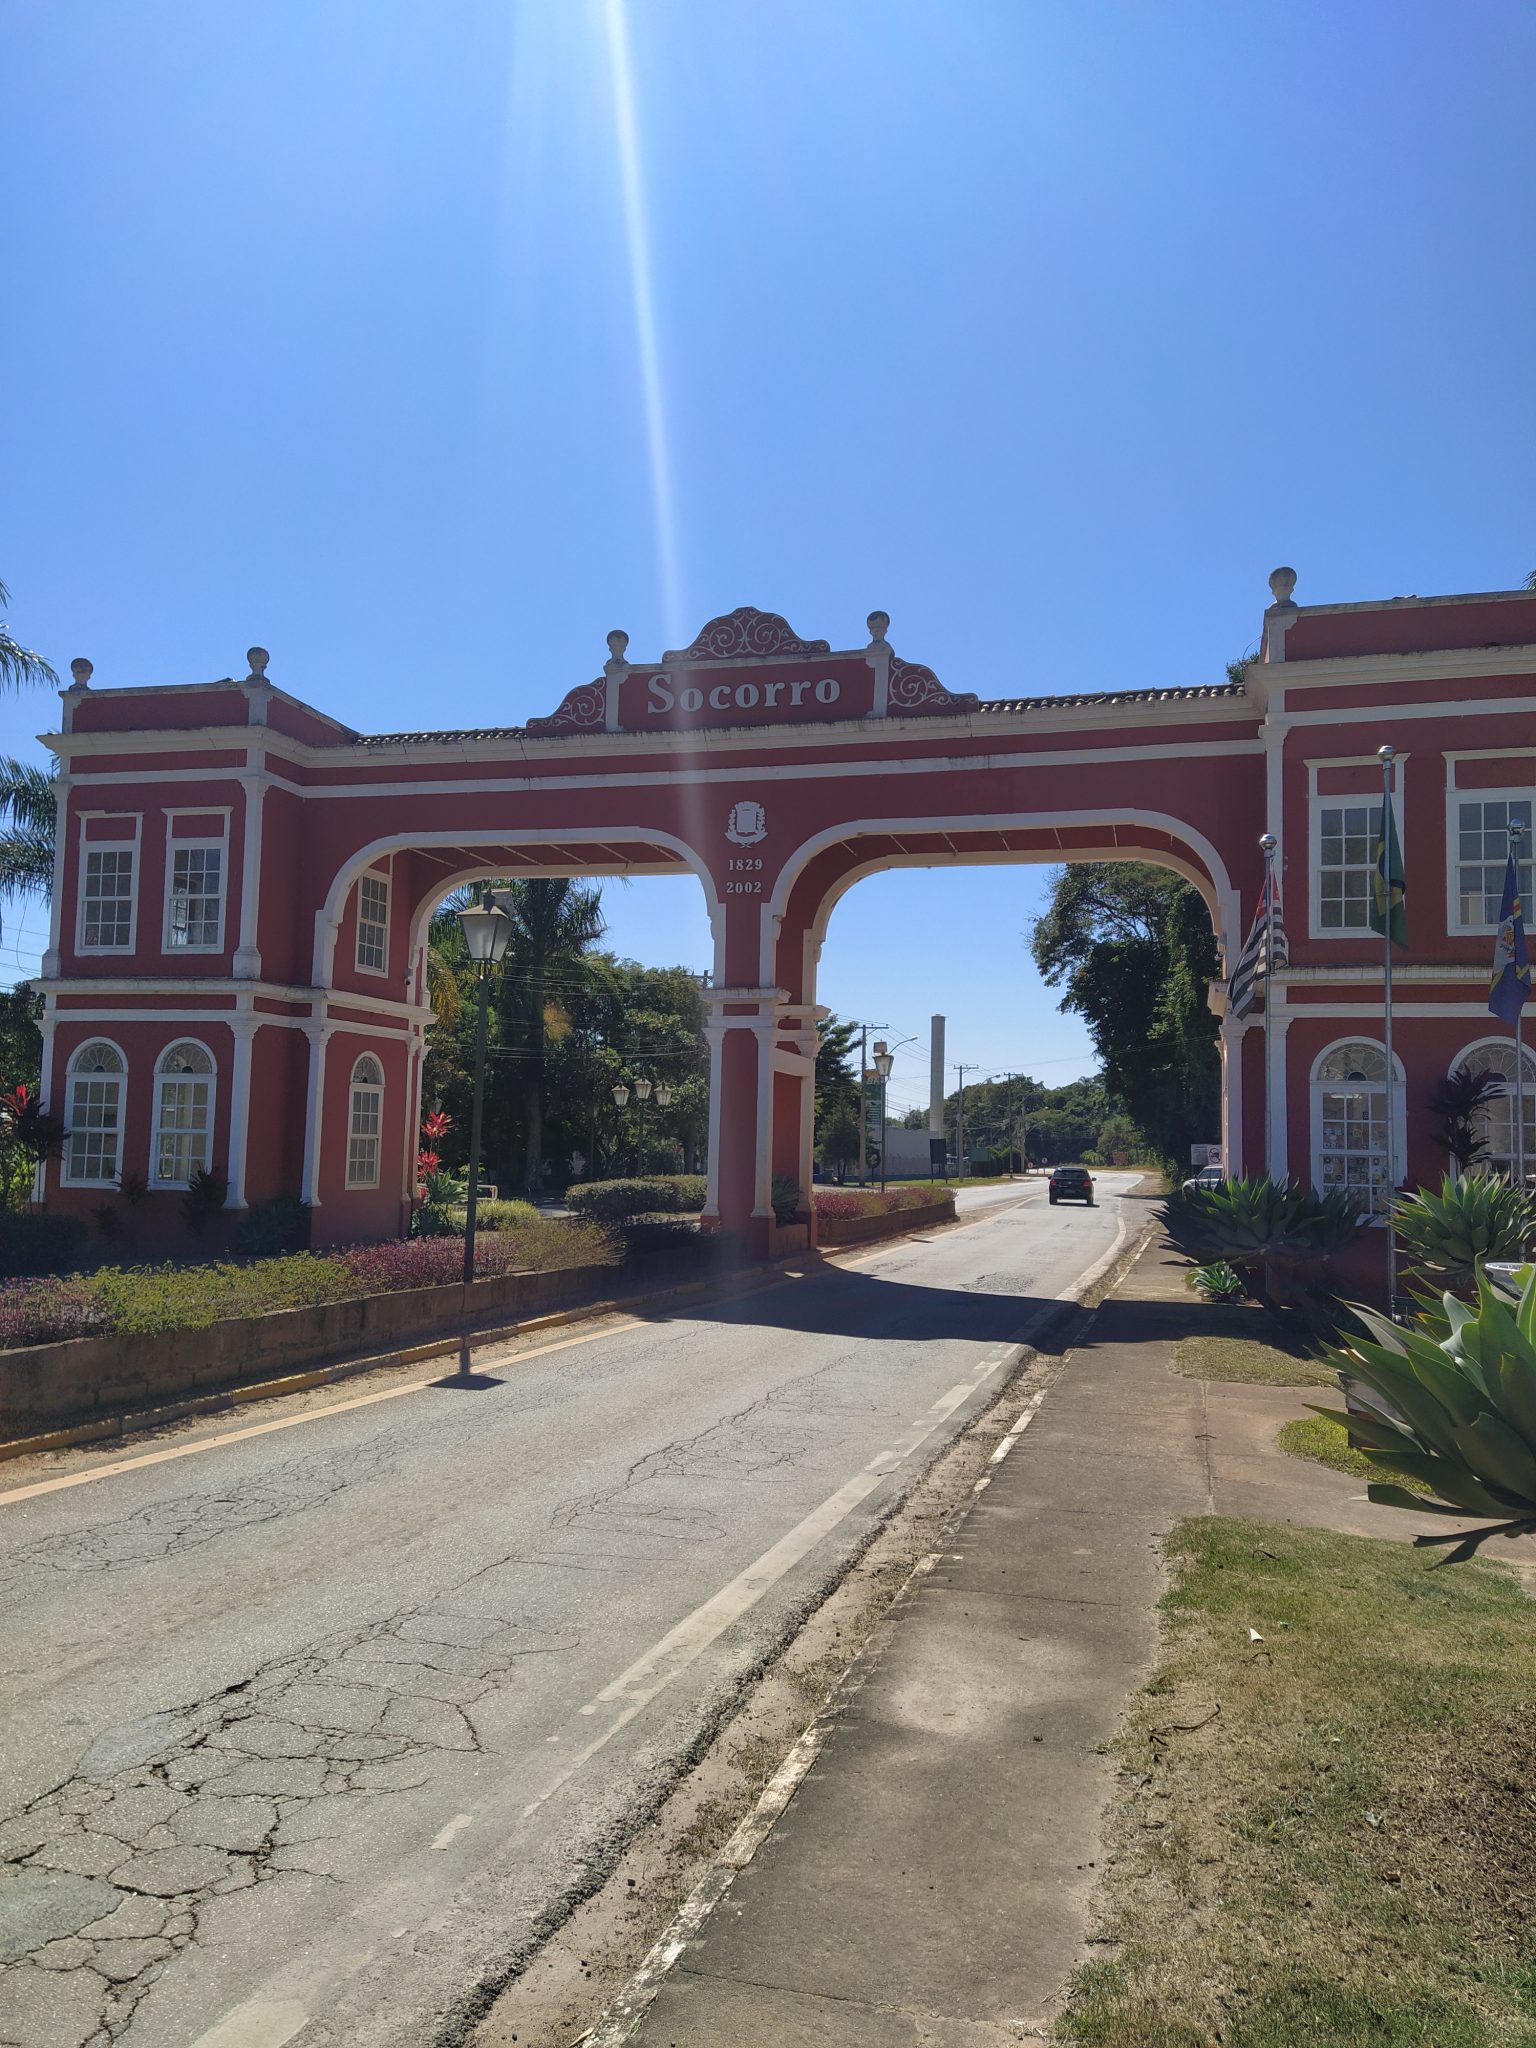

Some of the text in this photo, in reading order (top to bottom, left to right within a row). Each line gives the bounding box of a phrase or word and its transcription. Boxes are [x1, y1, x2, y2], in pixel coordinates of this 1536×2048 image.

[647, 673, 841, 714] Socorro
[728, 859, 763, 871] 1829
[726, 882, 762, 893] 2002
